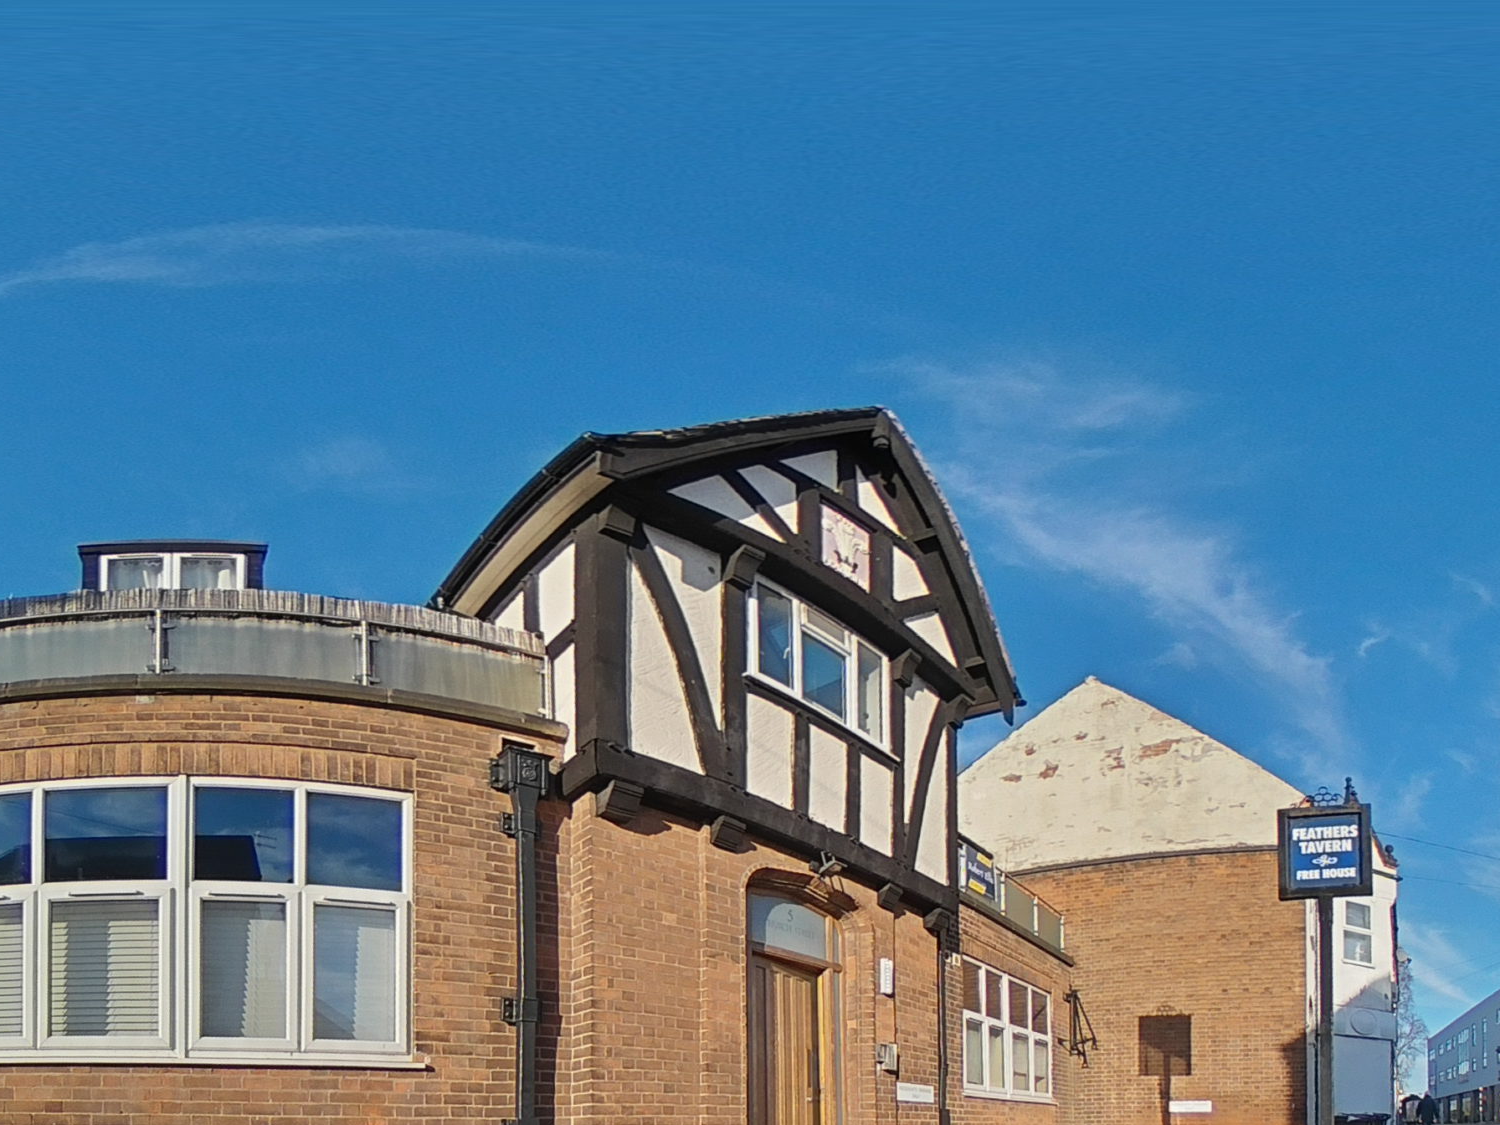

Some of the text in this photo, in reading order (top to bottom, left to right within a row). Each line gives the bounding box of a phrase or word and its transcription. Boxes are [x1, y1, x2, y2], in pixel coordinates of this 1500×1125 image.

[1292, 825, 1358, 841] FEATHERS
[1298, 839, 1353, 854] TAVERN
[1296, 867, 1356, 880] FREE HOUSE
